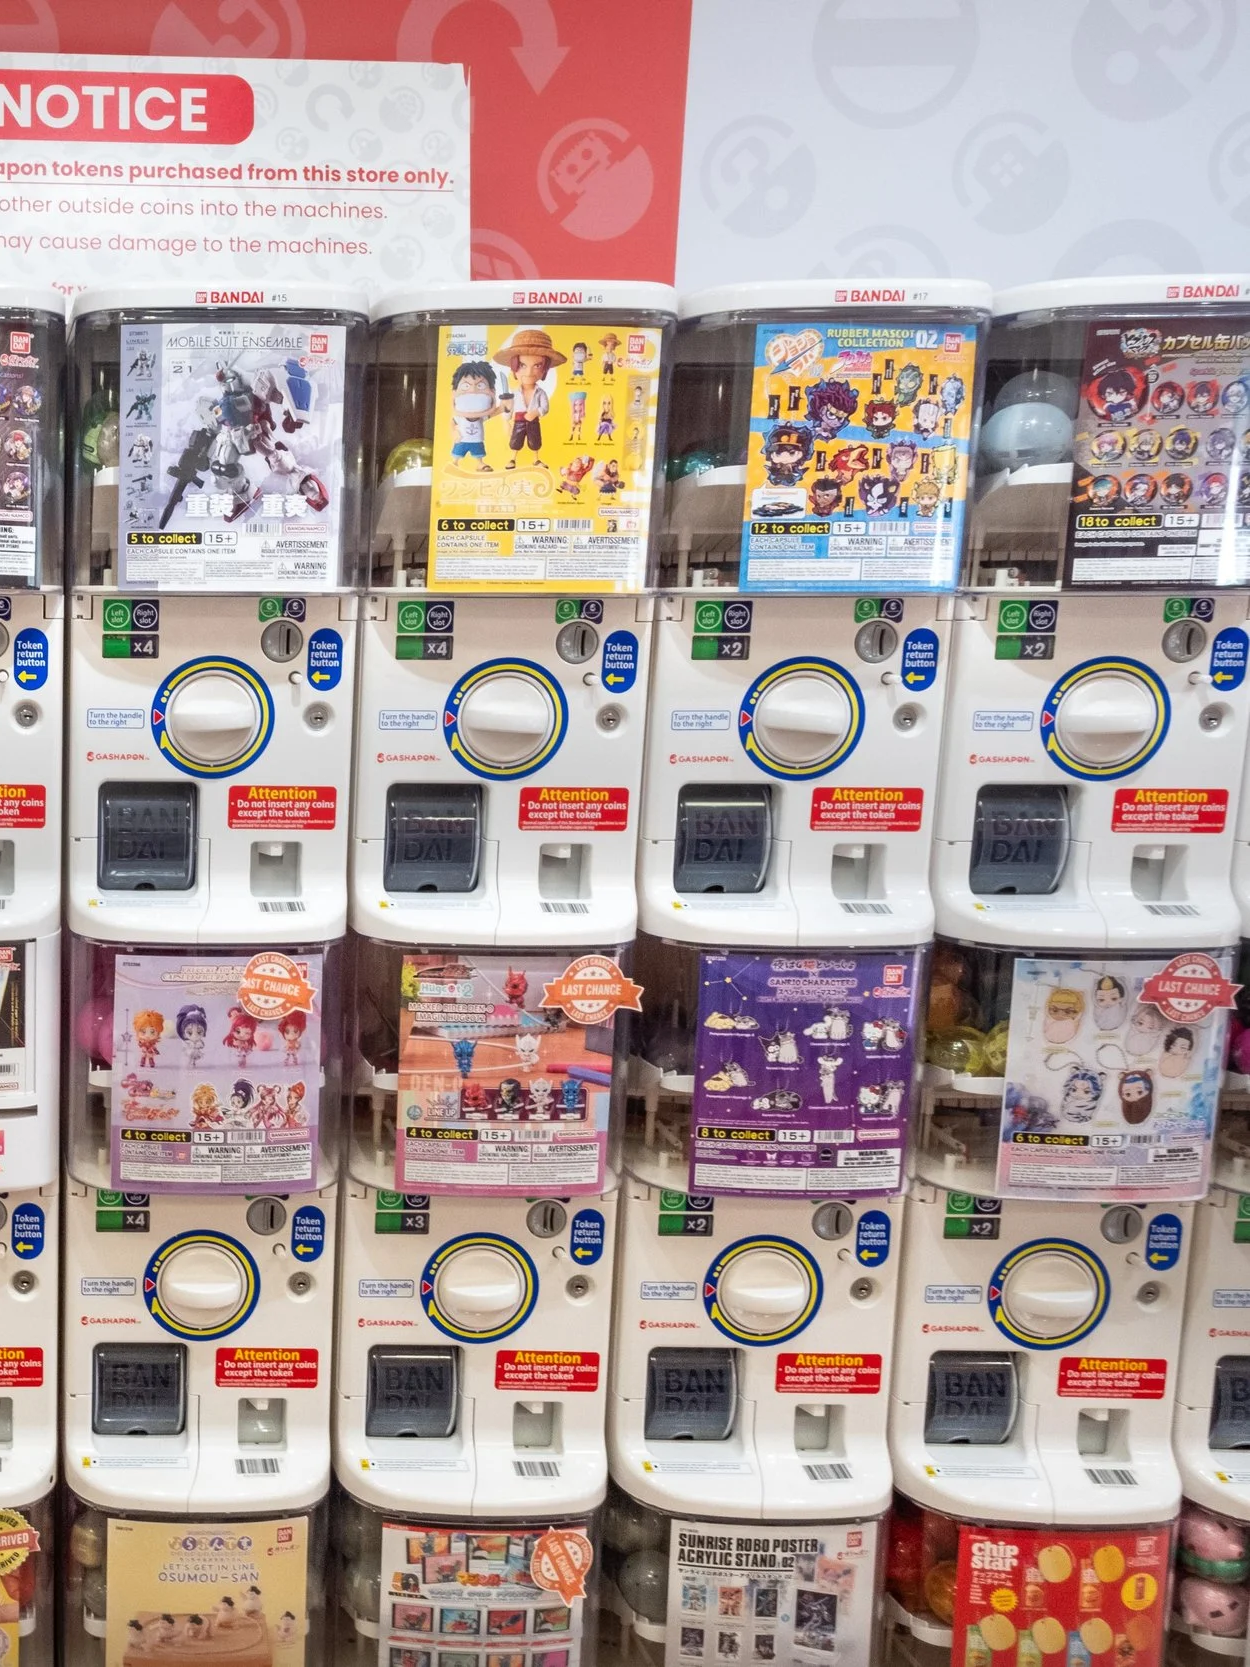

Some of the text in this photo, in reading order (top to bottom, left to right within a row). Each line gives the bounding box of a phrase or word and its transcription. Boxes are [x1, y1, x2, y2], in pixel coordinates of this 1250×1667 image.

[52, 158, 124, 180] tokens
[129, 159, 242, 184] purchased
[248, 163, 296, 182] from
[302, 163, 341, 183] this
[346, 166, 399, 184] store
[404, 165, 454, 189] only.
[58, 195, 134, 216] outside
[141, 198, 193, 218] coins
[200, 198, 238, 218] into
[244, 199, 276, 219] the
[282, 199, 388, 220] machines.
[40, 235, 101, 252] cause
[108, 232, 196, 257] damage
[202, 236, 224, 254] to
[229, 234, 261, 254] the
[268, 234, 373, 256] machines.
[851, 290, 905, 301] BANDAI
[1184, 285, 1239, 298] BANDAI
[211, 292, 263, 303] BANDAI
[529, 292, 582, 304] BANDAI
[588, 295, 602, 303] #16
[827, 328, 914, 338] RUBBER MASCOT
[166, 336, 302, 348] MOBILE SUIT ENSEMBLE
[838, 338, 903, 348] COLLECTION
[915, 330, 938, 349] 02
[754, 524, 829, 534] 12 to collect
[837, 524, 861, 533] 15+
[131, 534, 196, 543] 5 to collect
[209, 534, 232, 543] 15+
[137, 609, 154, 618] Right
[140, 616, 151, 624] slot
[17, 641, 43, 650] Token
[17, 658, 45, 667] button
[4, 800, 19, 808] any
[22, 799, 43, 807] coins
[562, 984, 621, 996] LAST CHANCE
[1158, 982, 1221, 996] LAST CHANCE
[679, 1533, 818, 1553] SUNRISE ROBO POSTER
[678, 1549, 776, 1568] ACRYLIC STAND
